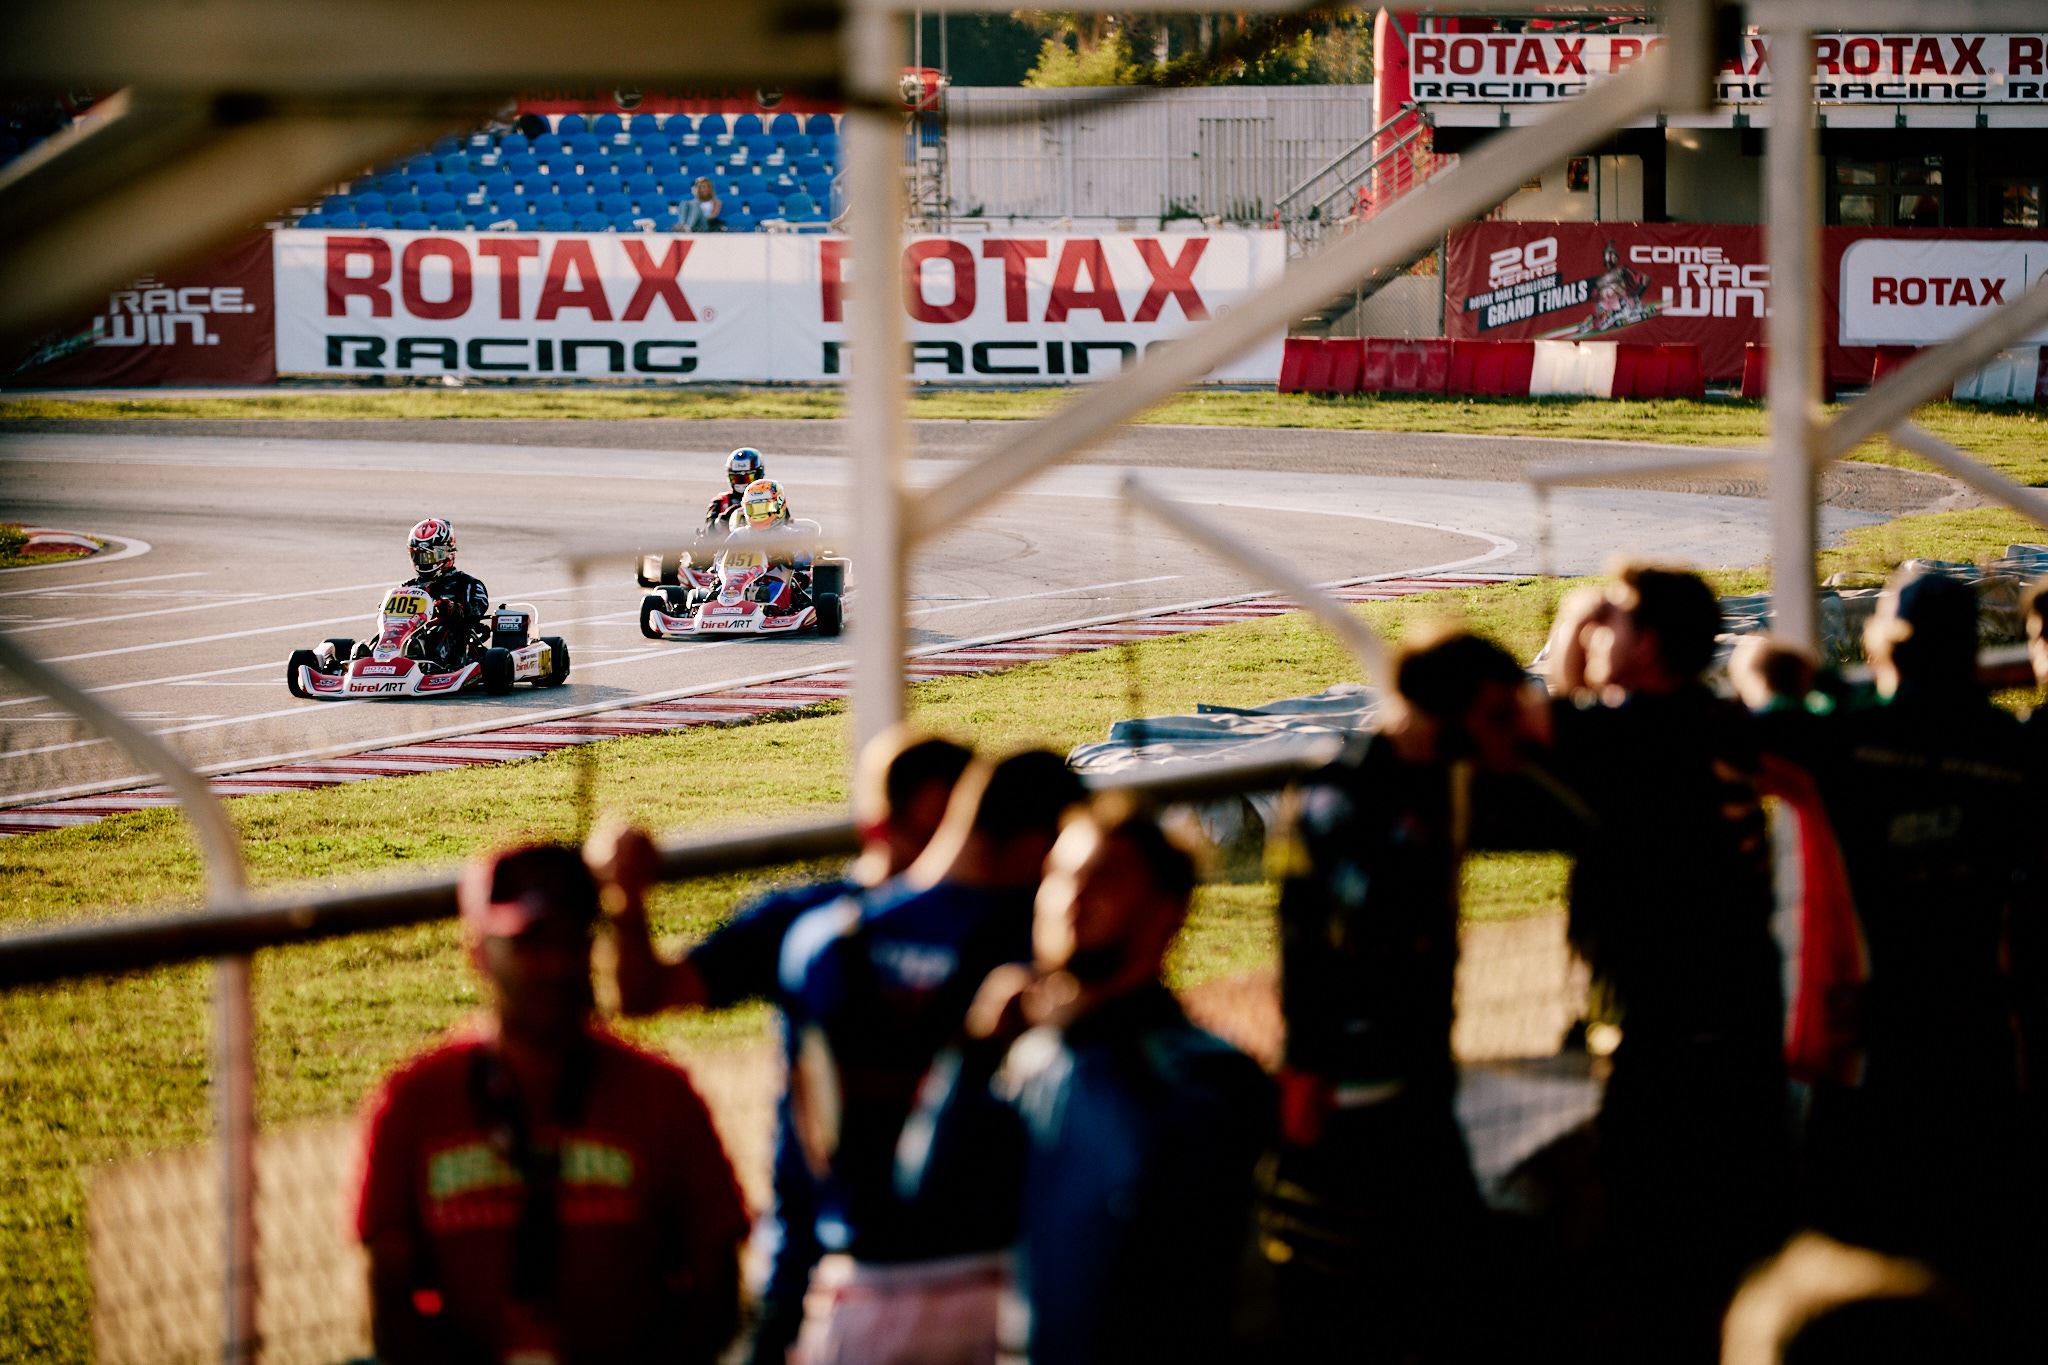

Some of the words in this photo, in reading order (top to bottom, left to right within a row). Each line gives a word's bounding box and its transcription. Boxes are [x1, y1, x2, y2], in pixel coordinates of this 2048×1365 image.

[1414, 37, 1588, 75] ROTAX
[1811, 37, 1986, 75] ROTAX
[2008, 37, 2048, 75] R
[1414, 82, 1587, 97] RACING
[1813, 83, 1986, 98] RACING
[1489, 236, 1558, 277] 20
[324, 236, 698, 322] ROTAX
[1488, 262, 1557, 289] YEARS
[1678, 264, 1770, 288] RAC
[110, 287, 255, 315] RACE.
[1487, 294, 1535, 328] GRAND
[1538, 280, 1588, 313] FINALS
[1872, 276, 2007, 306] ROTAX
[93, 313, 219, 346] WIN.
[326, 335, 698, 373] RACING
[385, 596, 420, 614] 405
[701, 619, 752, 629] birelART
[350, 682, 406, 692] birelART
